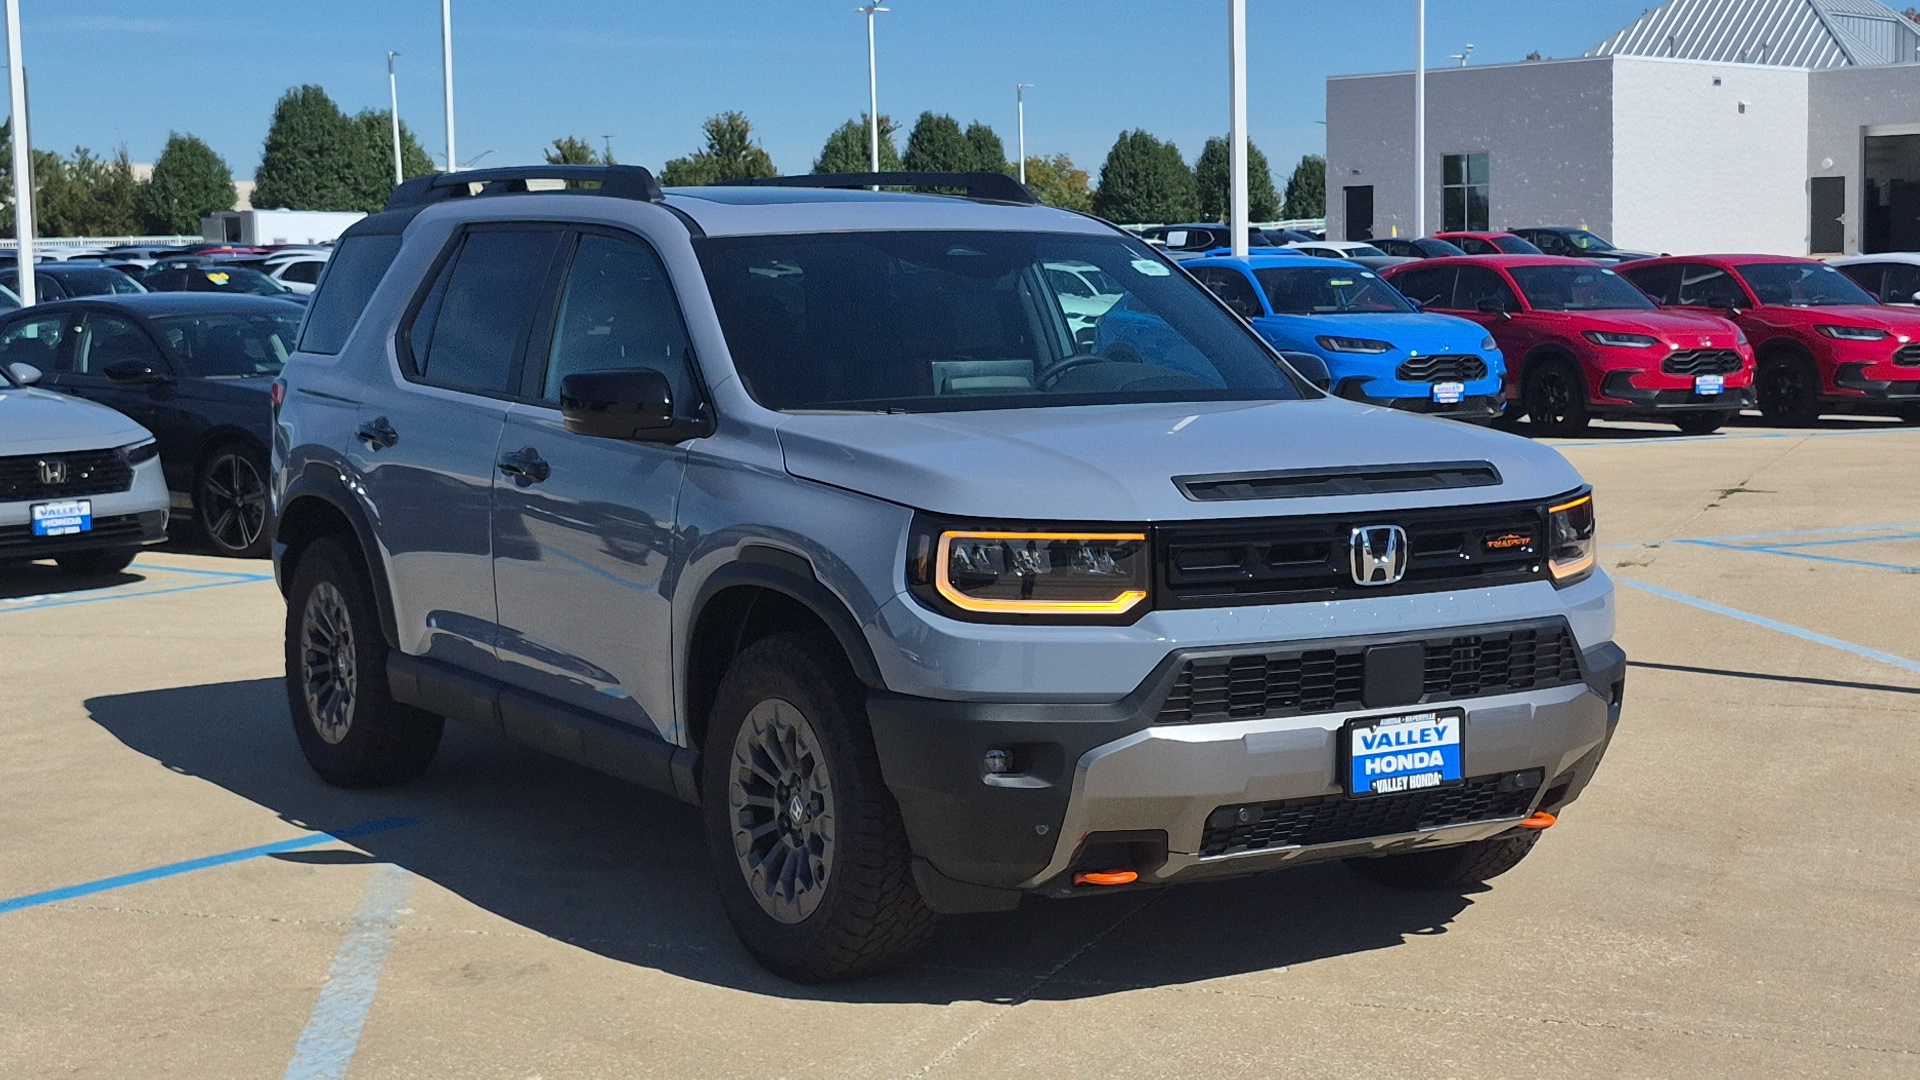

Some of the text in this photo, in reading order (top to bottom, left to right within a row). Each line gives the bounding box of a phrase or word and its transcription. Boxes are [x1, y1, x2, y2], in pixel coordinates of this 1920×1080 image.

[40, 506, 83, 516] VALLEY
[1361, 725, 1448, 750] VALLEY
[1365, 750, 1444, 775] HONDA
[1376, 772, 1440, 793] VALLEY HONDA
